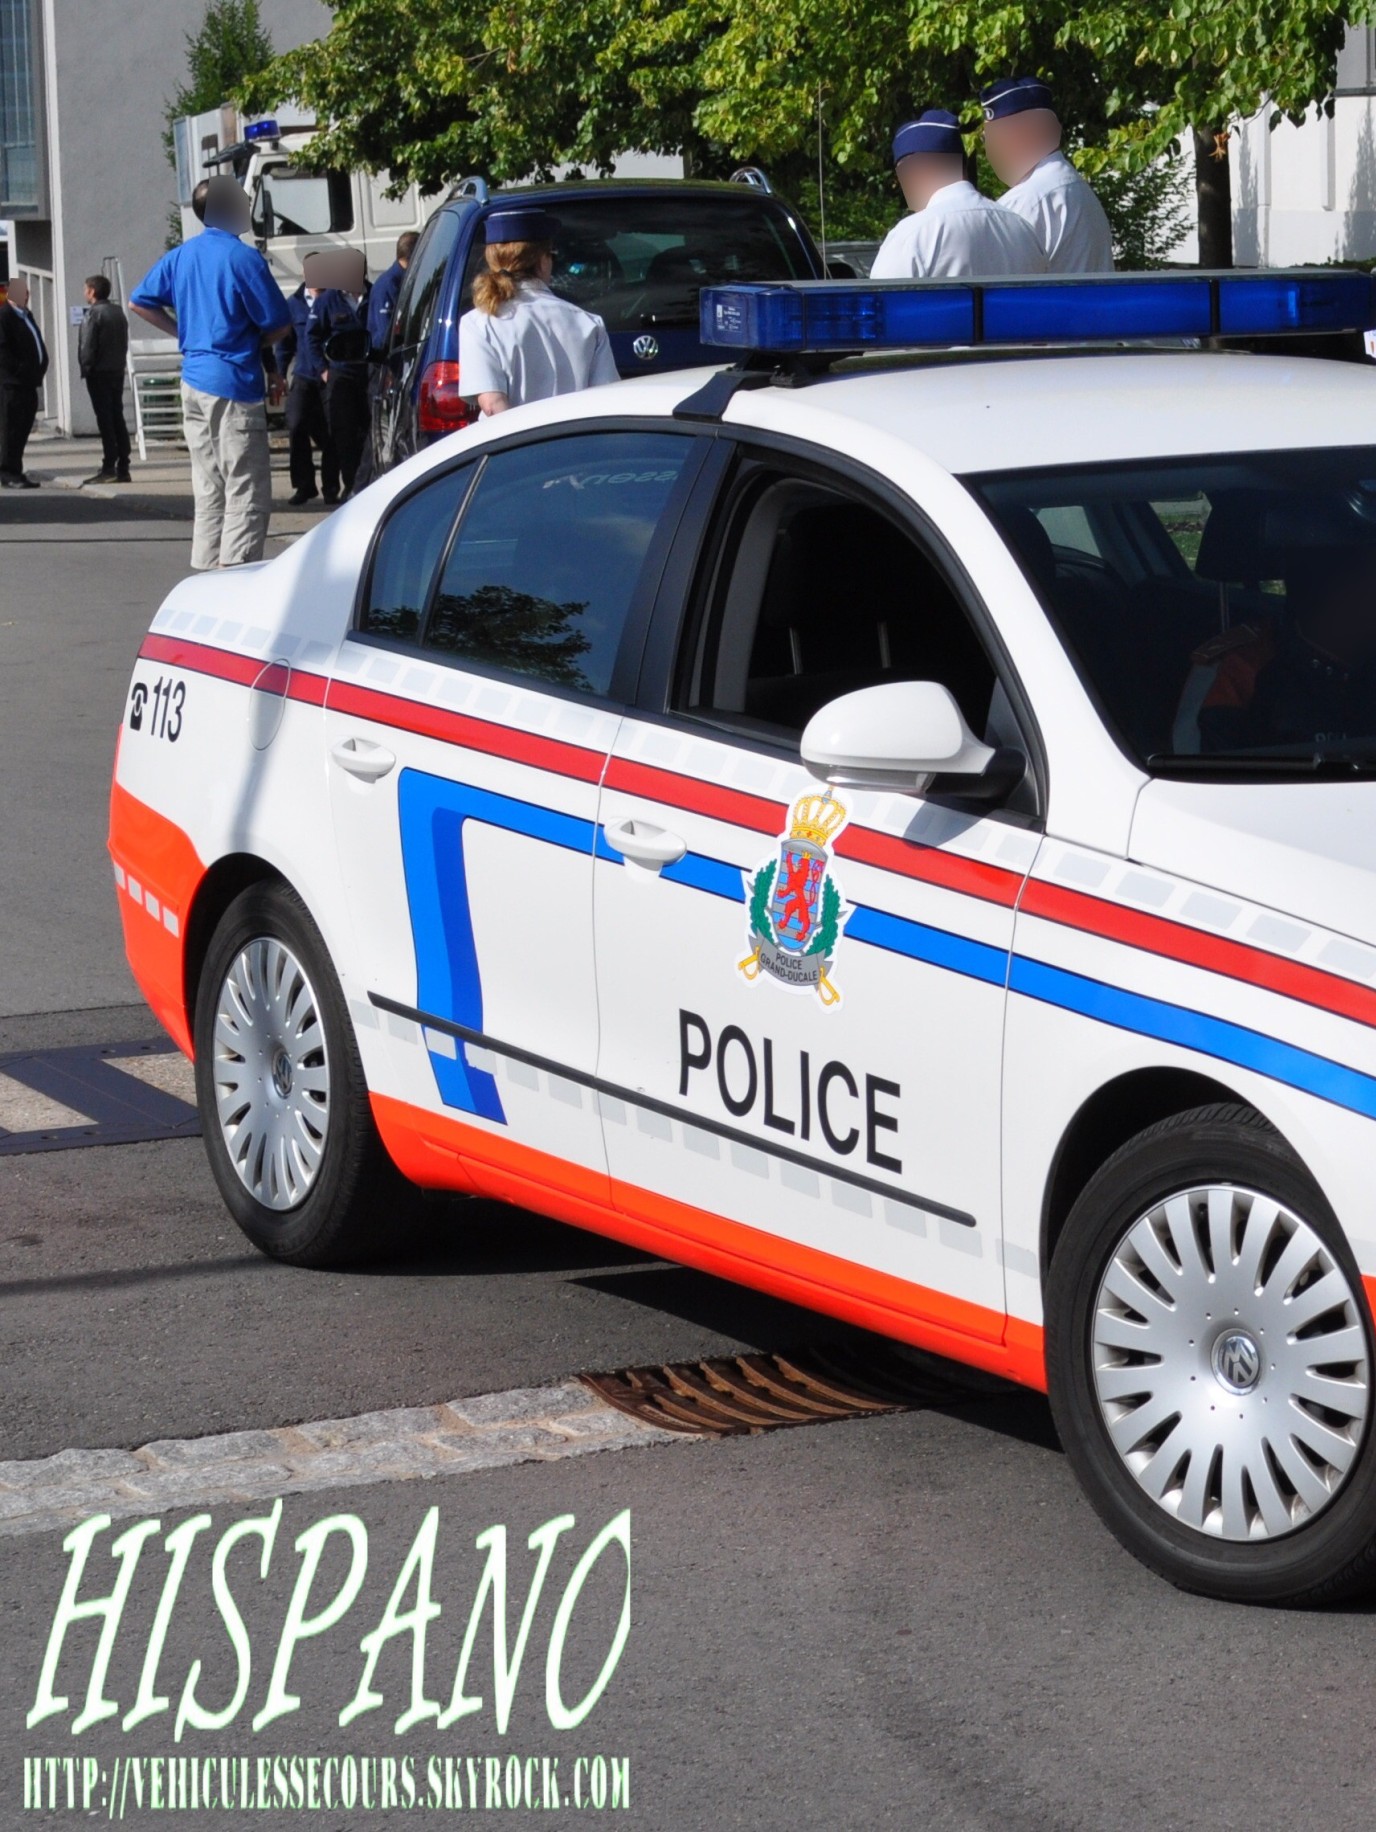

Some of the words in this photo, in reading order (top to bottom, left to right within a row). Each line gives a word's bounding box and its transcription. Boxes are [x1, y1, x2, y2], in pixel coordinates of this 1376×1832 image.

[151, 676, 186, 743] 113
[760, 953, 818, 983] GRAND-DUCALE
[776, 952, 802, 970] POLICE
[679, 1008, 902, 1175] POLICE
